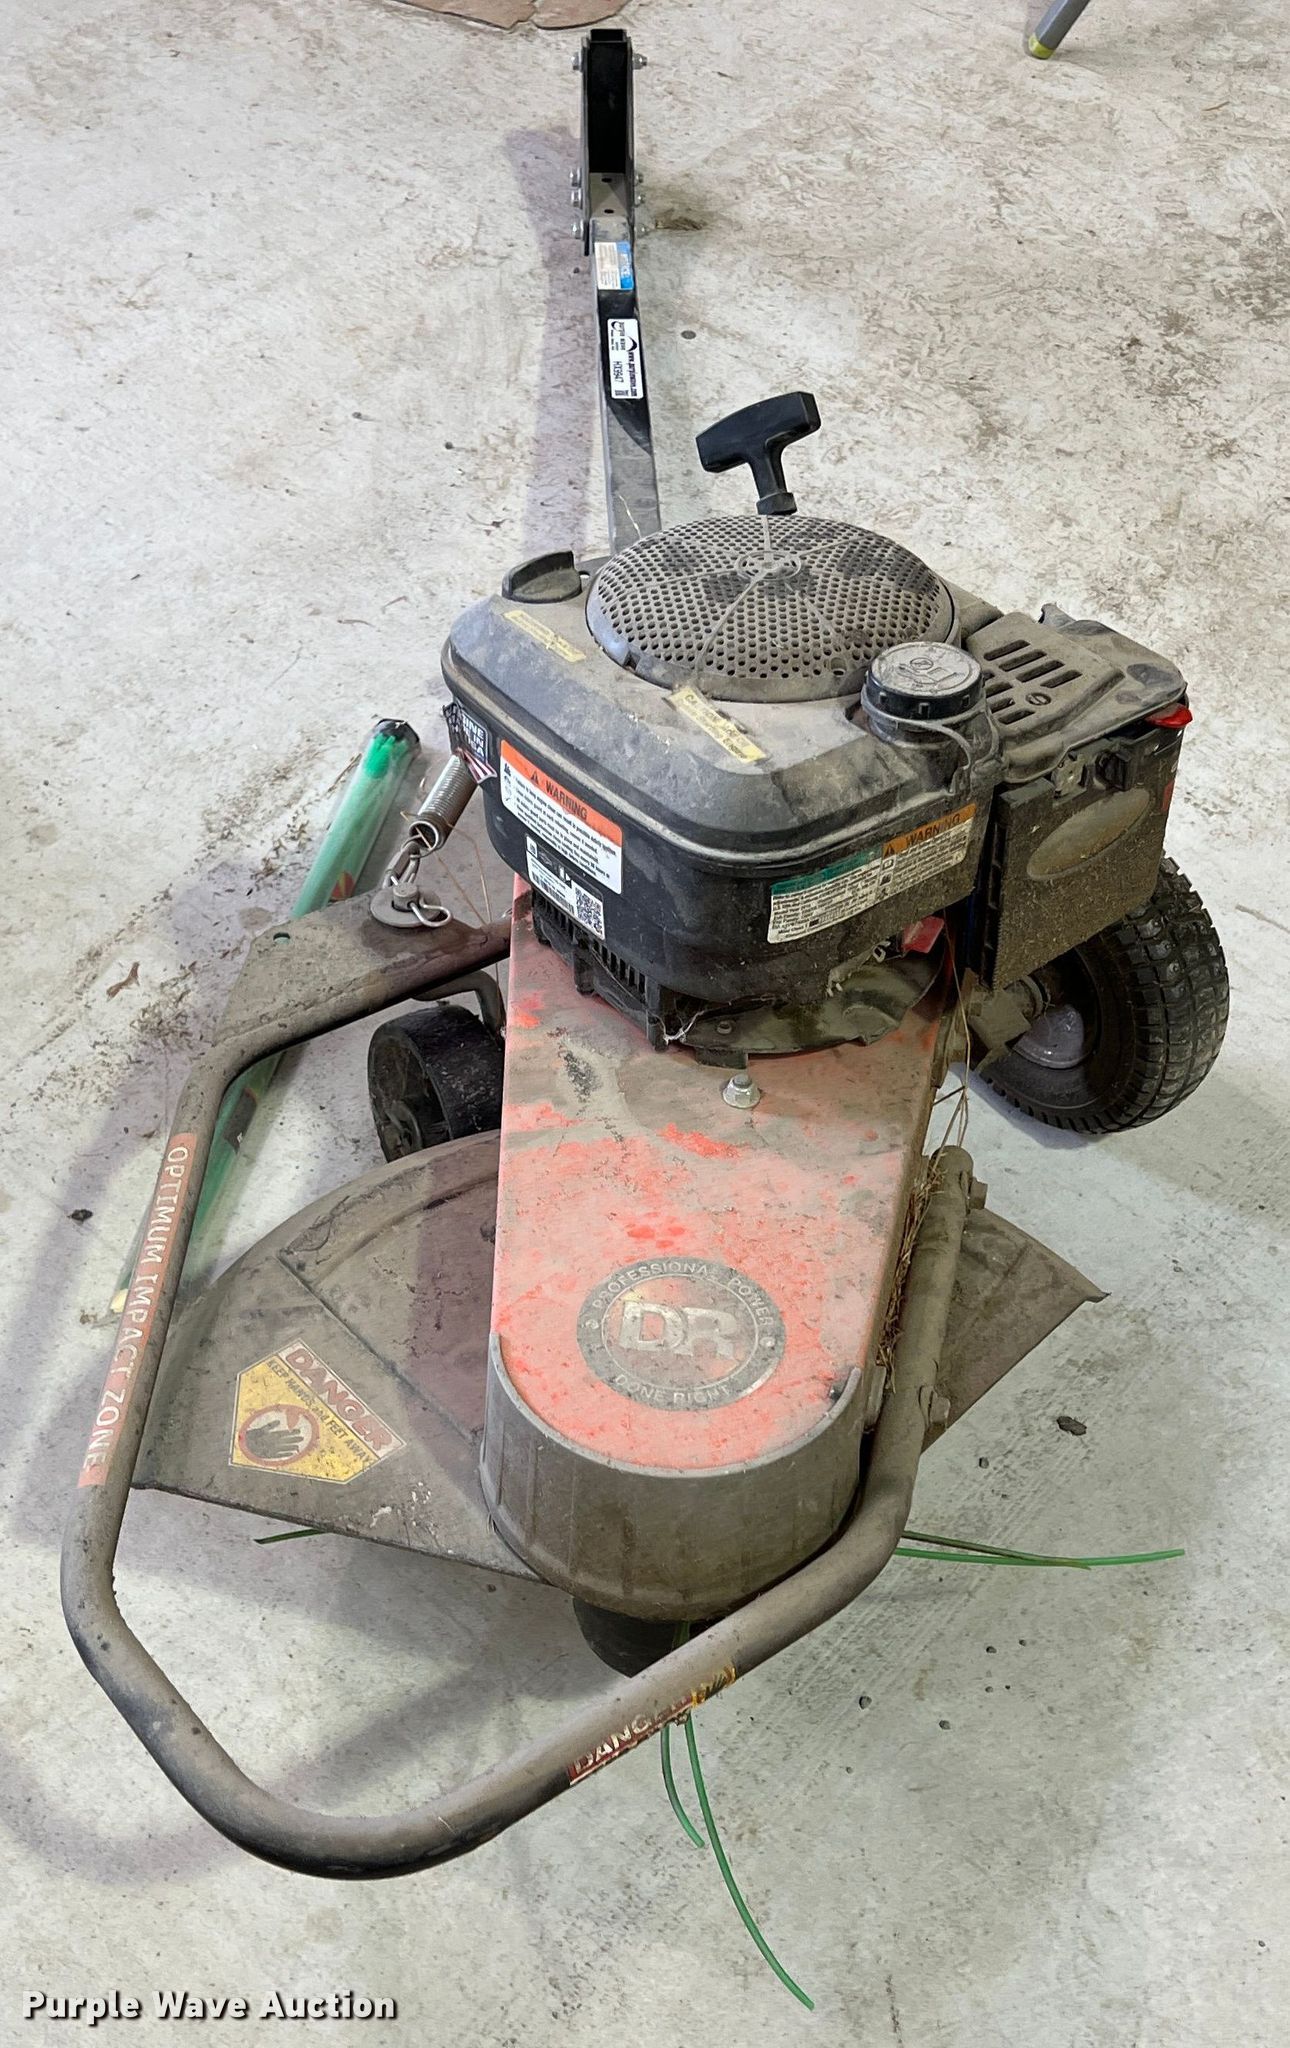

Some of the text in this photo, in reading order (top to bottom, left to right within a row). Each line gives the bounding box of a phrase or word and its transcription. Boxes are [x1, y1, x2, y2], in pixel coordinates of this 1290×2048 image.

[545, 781, 588, 821] WARNING
[83, 1145, 188, 1470] OPTIMUM IMPACT ZONE
[619, 1301, 738, 1359] DR
[727, 1277, 775, 1327] POWER
[266, 1360, 289, 1378] KEEP
[326, 1419, 348, 1440] FEET
[285, 1348, 393, 1451] DANGER
[614, 1373, 732, 1404] DONE RIGHT
